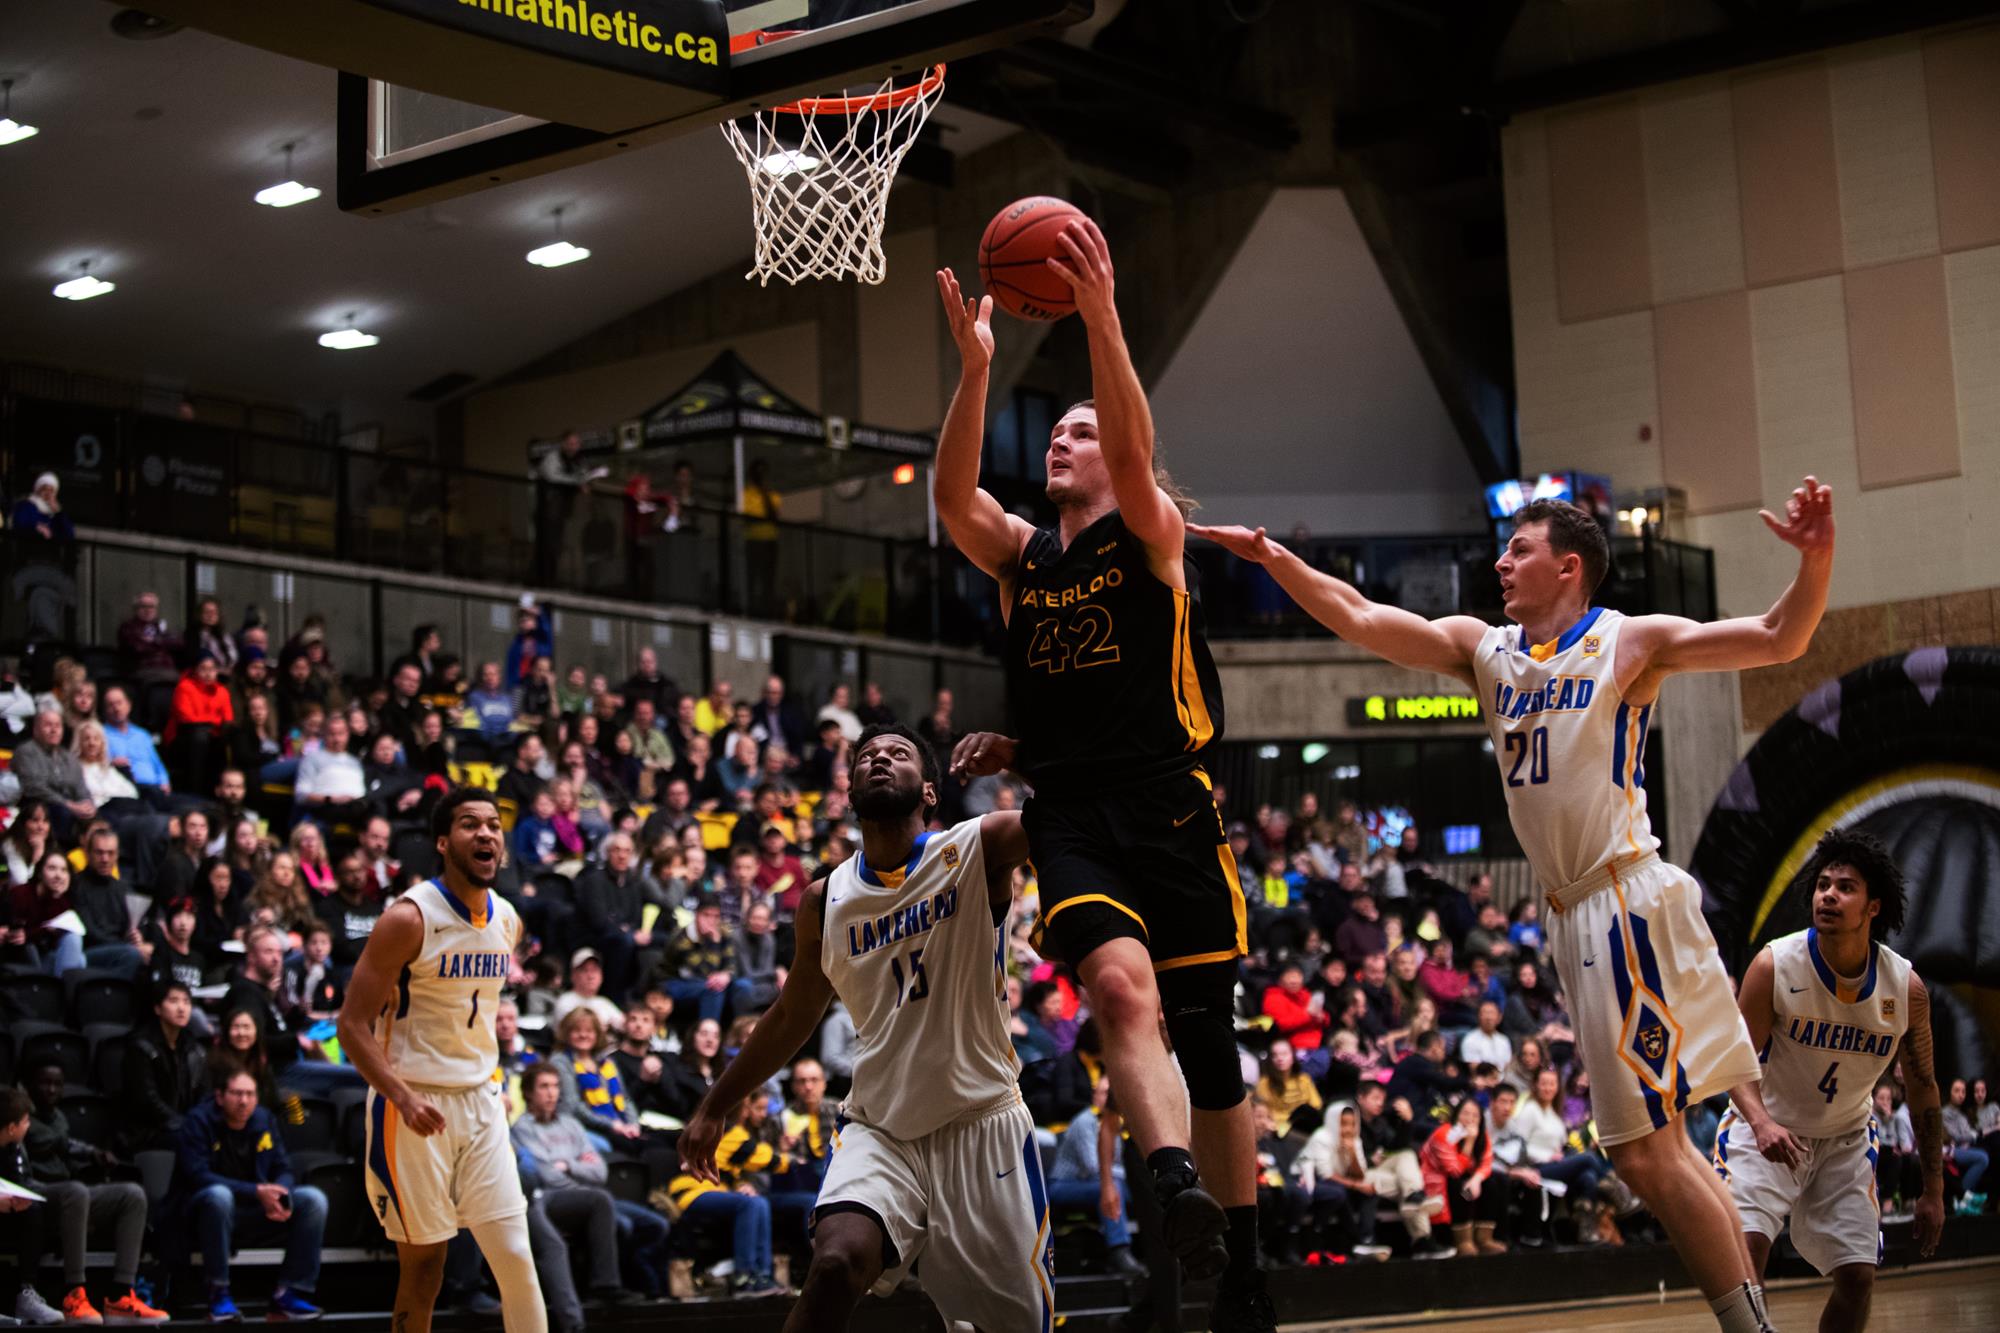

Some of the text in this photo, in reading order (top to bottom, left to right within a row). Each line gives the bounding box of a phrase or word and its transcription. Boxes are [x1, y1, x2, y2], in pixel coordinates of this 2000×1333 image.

[458, 0, 719, 65] athletic.ca
[1027, 604, 1121, 674] 42
[1396, 696, 1479, 720] NORTH
[1505, 726, 1549, 788] 20
[849, 885, 958, 957] LAKEHEAD
[891, 949, 929, 1008] 15
[467, 988, 480, 1029] 1
[1789, 1018, 1894, 1057] LAKEHEAD
[1817, 1062, 1841, 1104] 4
